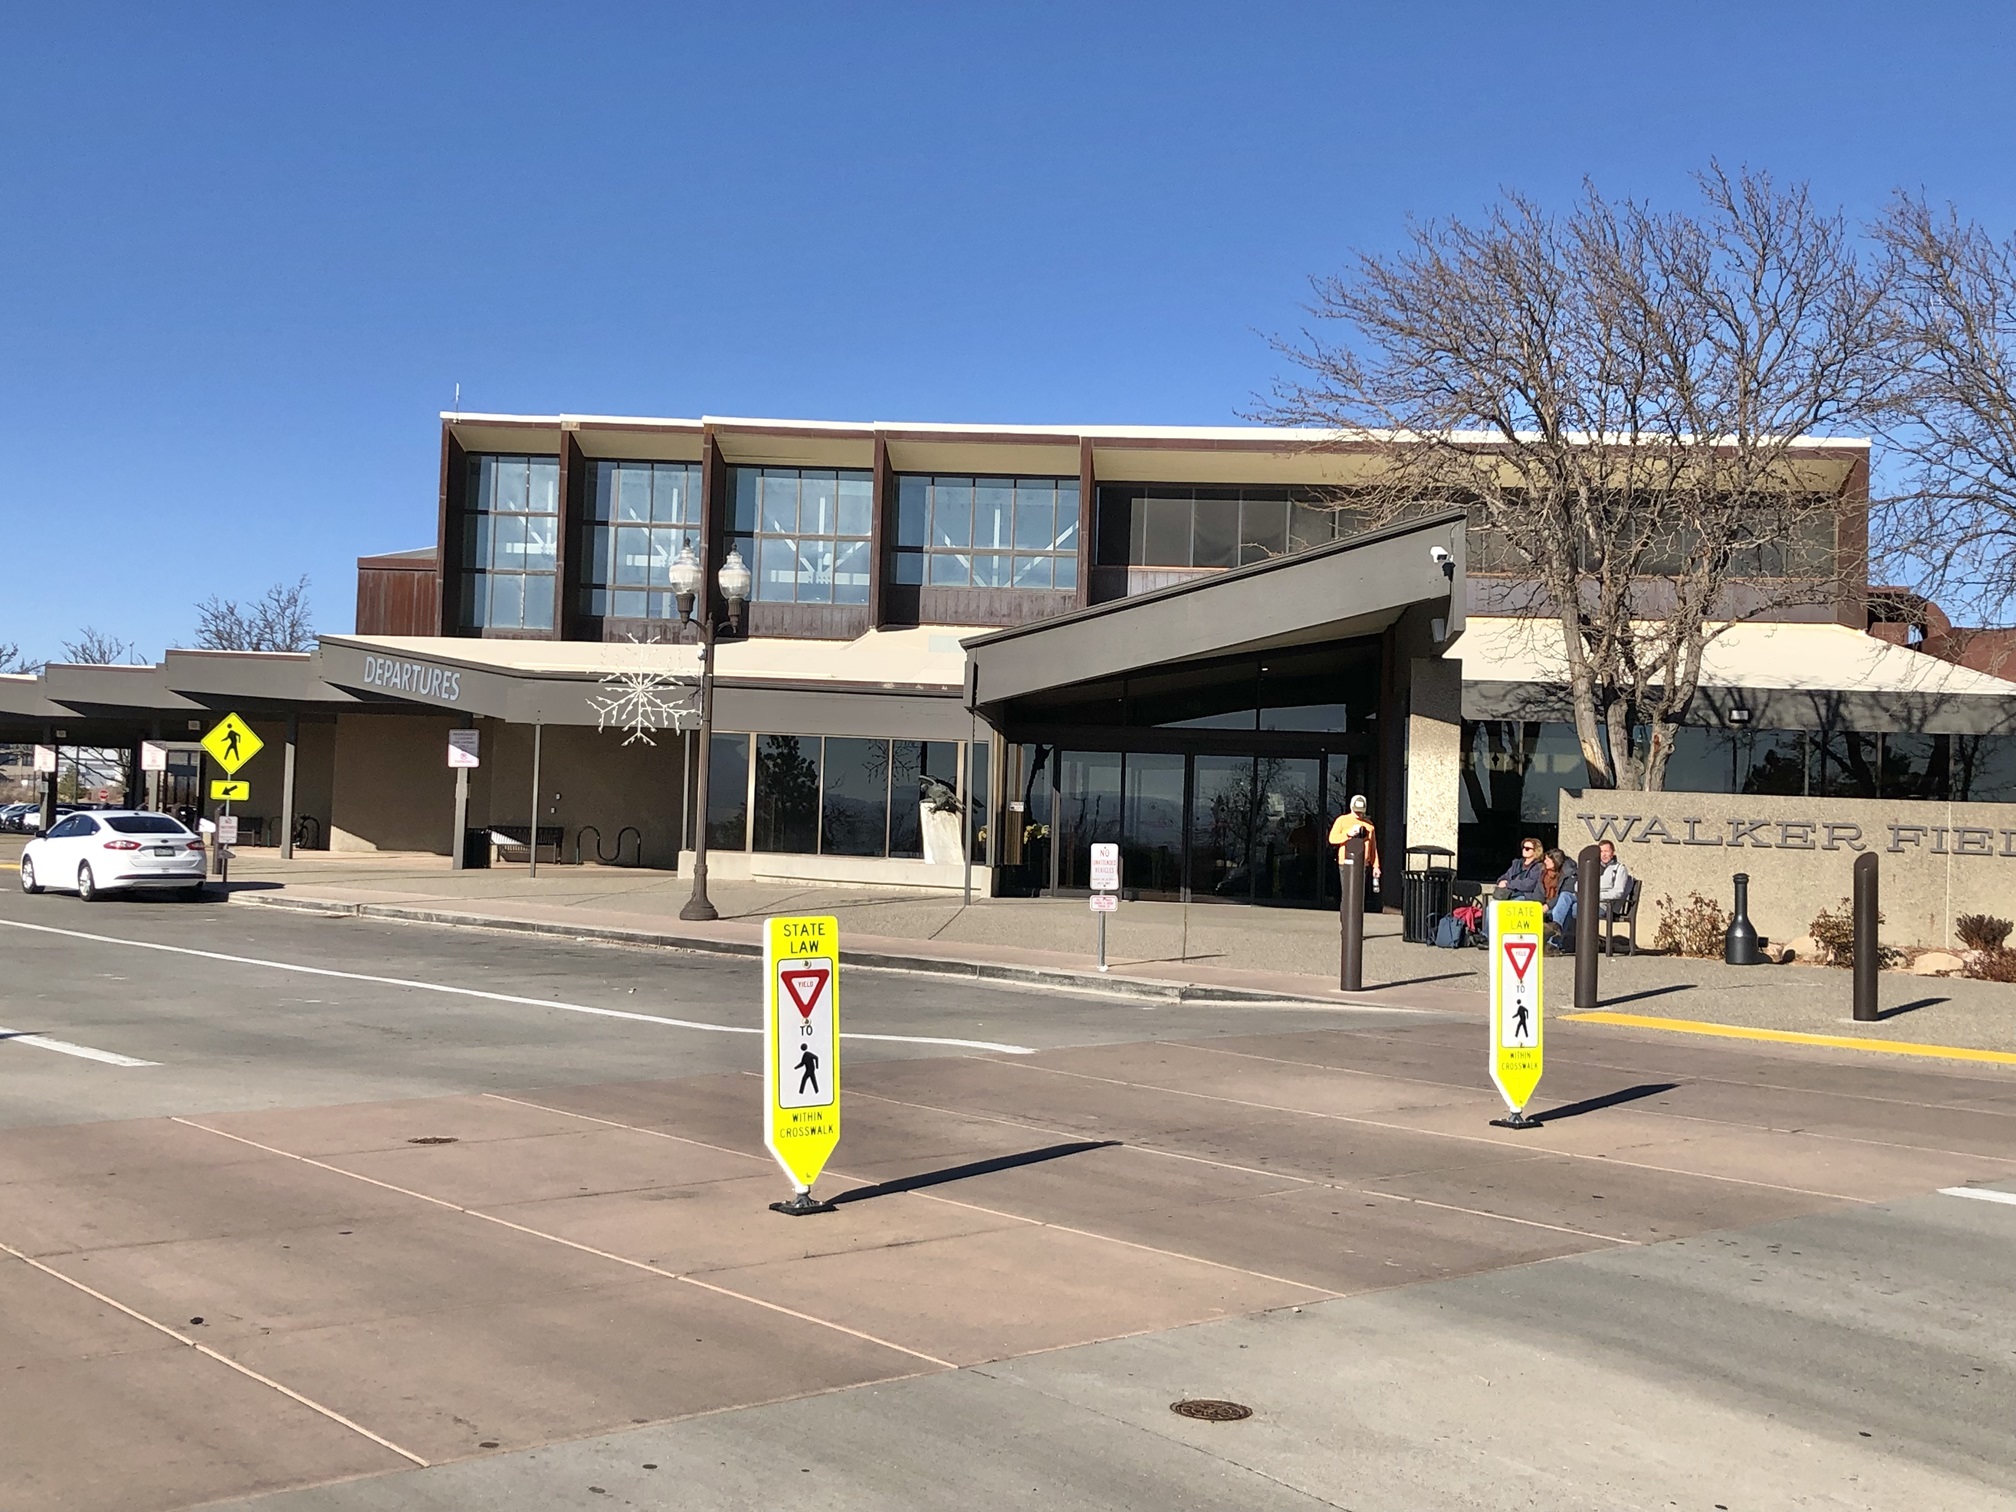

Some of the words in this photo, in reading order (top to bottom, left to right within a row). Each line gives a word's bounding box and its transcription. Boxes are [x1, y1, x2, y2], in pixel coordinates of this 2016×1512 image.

[364, 656, 461, 701] DEPARTURES
[1577, 812, 1867, 851] WALKER
[1100, 849, 1110, 858] NO
[1506, 907, 1535, 917] STATE
[783, 923, 826, 937] STATE
[1510, 920, 1531, 930] LAW
[790, 940, 819, 954] LAW
[1516, 985, 1526, 994] TO
[800, 1025, 813, 1036] TO
[1510, 1051, 1531, 1060] WITHIN
[1501, 1061, 1539, 1071] CROSSWALK
[792, 1111, 823, 1123] WITHIN
[779, 1124, 834, 1139] CROSSWALK
